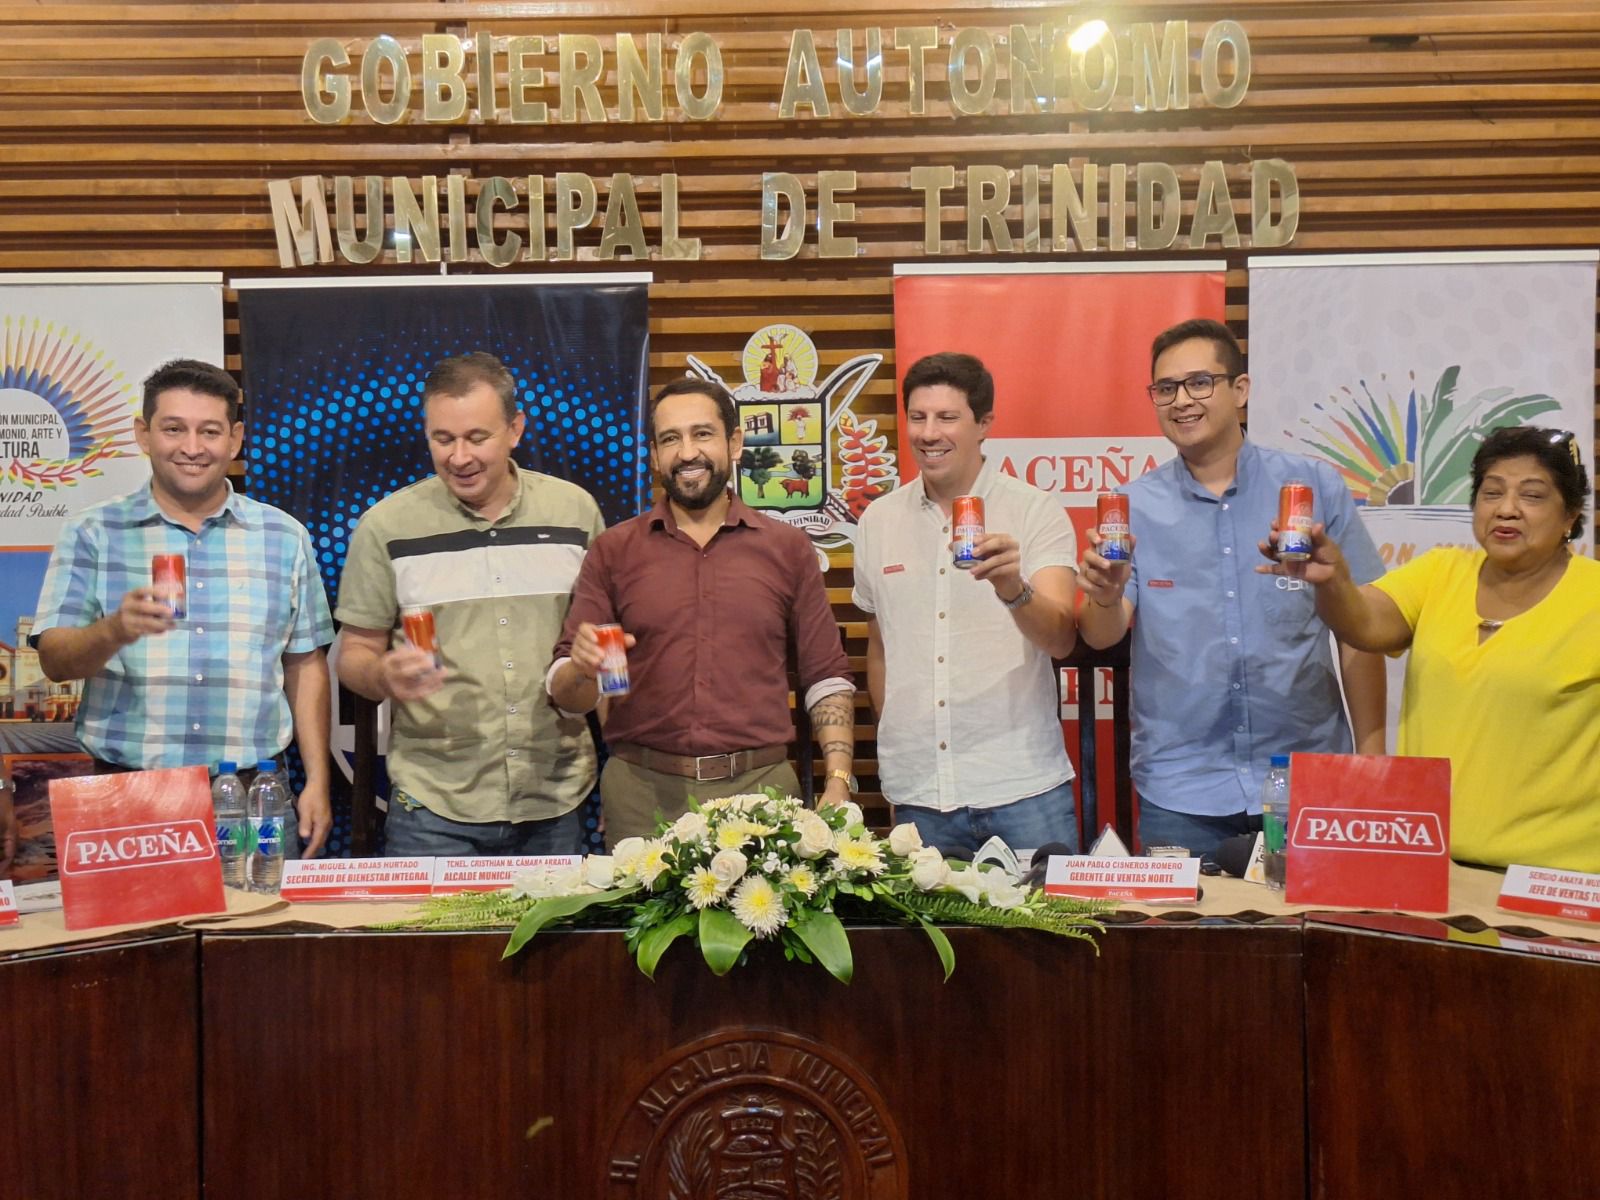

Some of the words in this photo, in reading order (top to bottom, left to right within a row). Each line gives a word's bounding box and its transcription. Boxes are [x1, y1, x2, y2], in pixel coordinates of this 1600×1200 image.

[301, 31, 724, 125] GOBIERNO
[778, 18, 1251, 119] AUTONOMO
[267, 172, 701, 269] MUNICIPAL
[761, 170, 858, 260] DE
[910, 158, 1300, 255] TRINIDAD
[11, 414, 59, 425] MUNICIPAL
[31, 428, 54, 439] ARTE
[56, 428, 62, 439] Y
[999, 445, 1160, 493] ACEÑ
[1306, 817, 1434, 846] PACEÑA
[76, 828, 204, 865] PACEÑA
[1066, 860, 1085, 868] JUAN
[1113, 861, 1149, 869] CISNEROS
[1151, 862, 1183, 870] ROMERO
[286, 874, 334, 884] SECRETARIO
[336, 874, 345, 882] DE
[348, 873, 389, 882] BIENESTAR
[391, 872, 429, 880] INTEGRAL
[444, 872, 477, 881] ALCALDE
[479, 871, 516, 880] MUNICI
[1070, 872, 1104, 881] GERENTE
[1105, 873, 1114, 882] DE
[1117, 873, 1146, 883] VENTAS
[1148, 874, 1174, 883] NORTE
[1529, 884, 1545, 895] JEFE
[1547, 886, 1557, 897] DE
[1559, 887, 1590, 902] VENTAS
